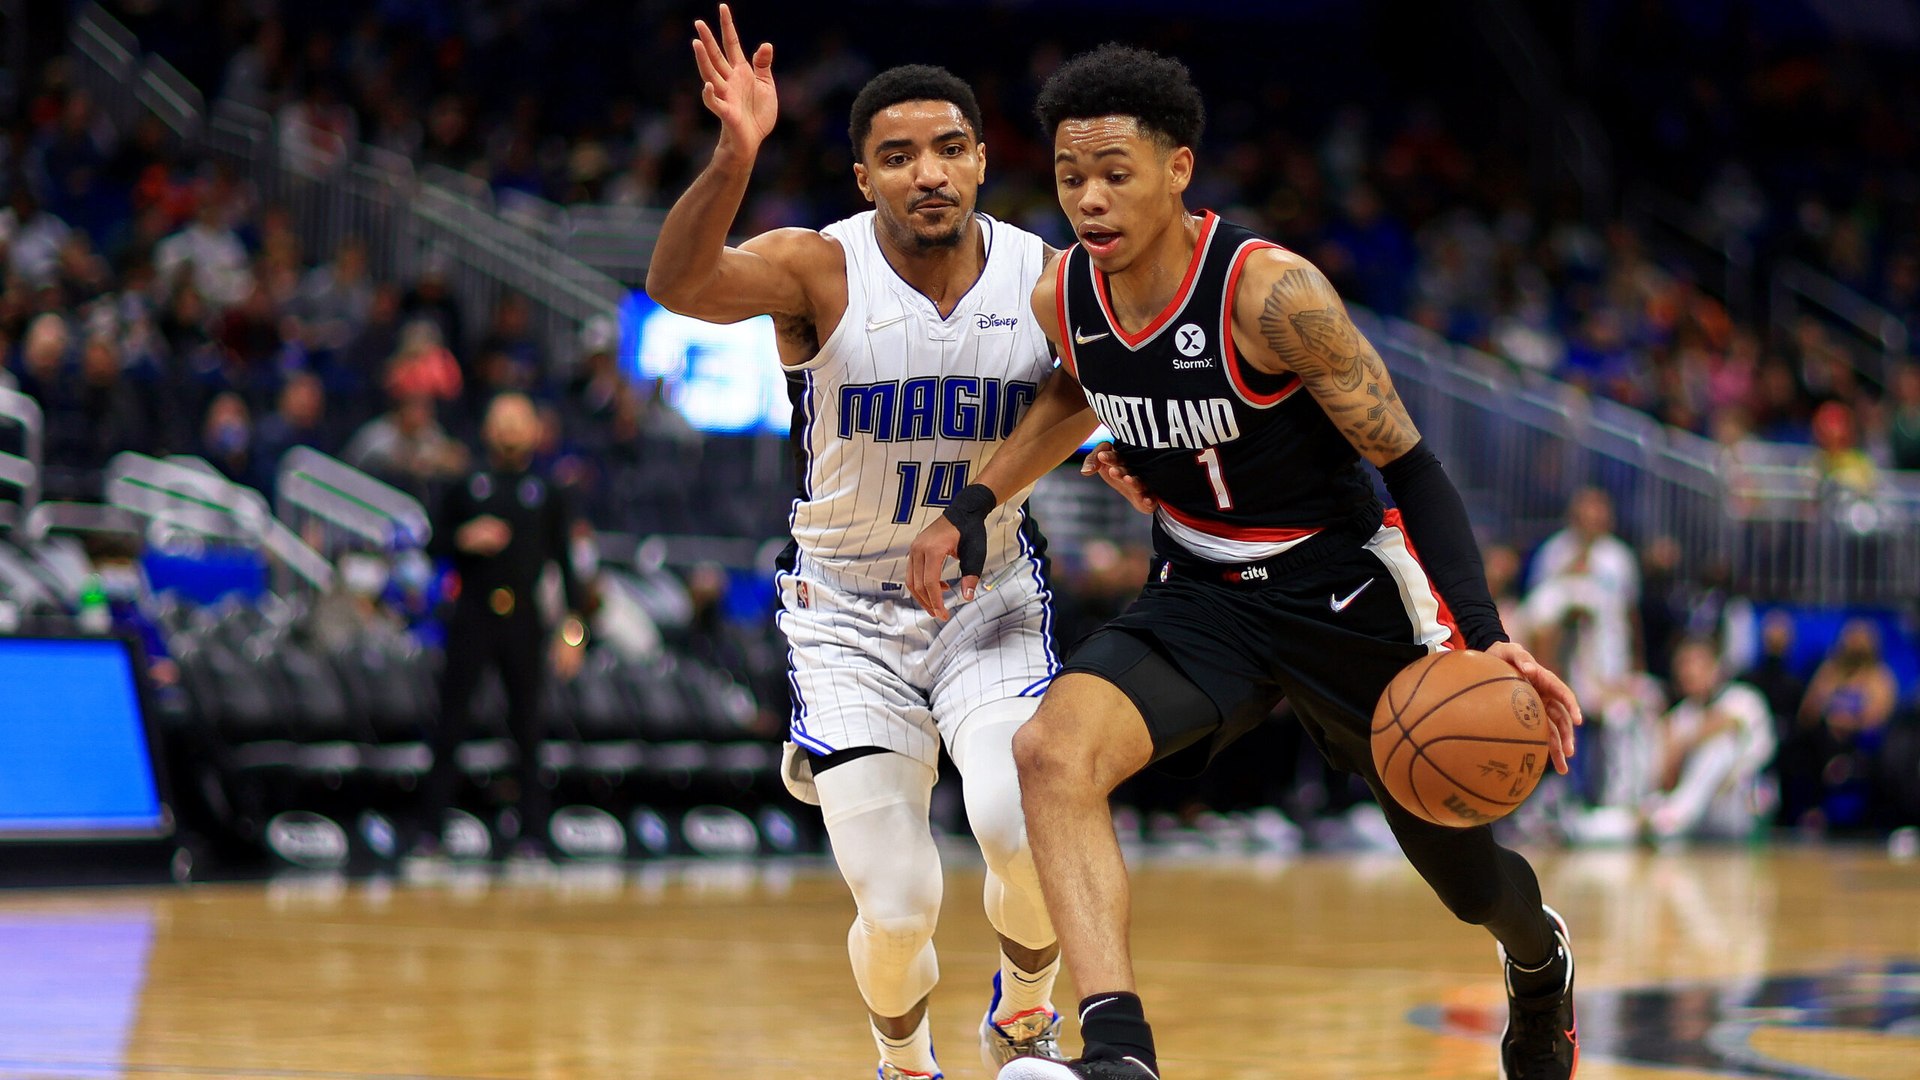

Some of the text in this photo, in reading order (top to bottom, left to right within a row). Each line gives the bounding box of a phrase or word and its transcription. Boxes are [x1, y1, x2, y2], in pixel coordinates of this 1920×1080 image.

[1172, 357, 1213, 370] StormX
[837, 375, 1037, 442] MAGIC
[891, 460, 971, 524] 14
[1196, 447, 1233, 511] 1
